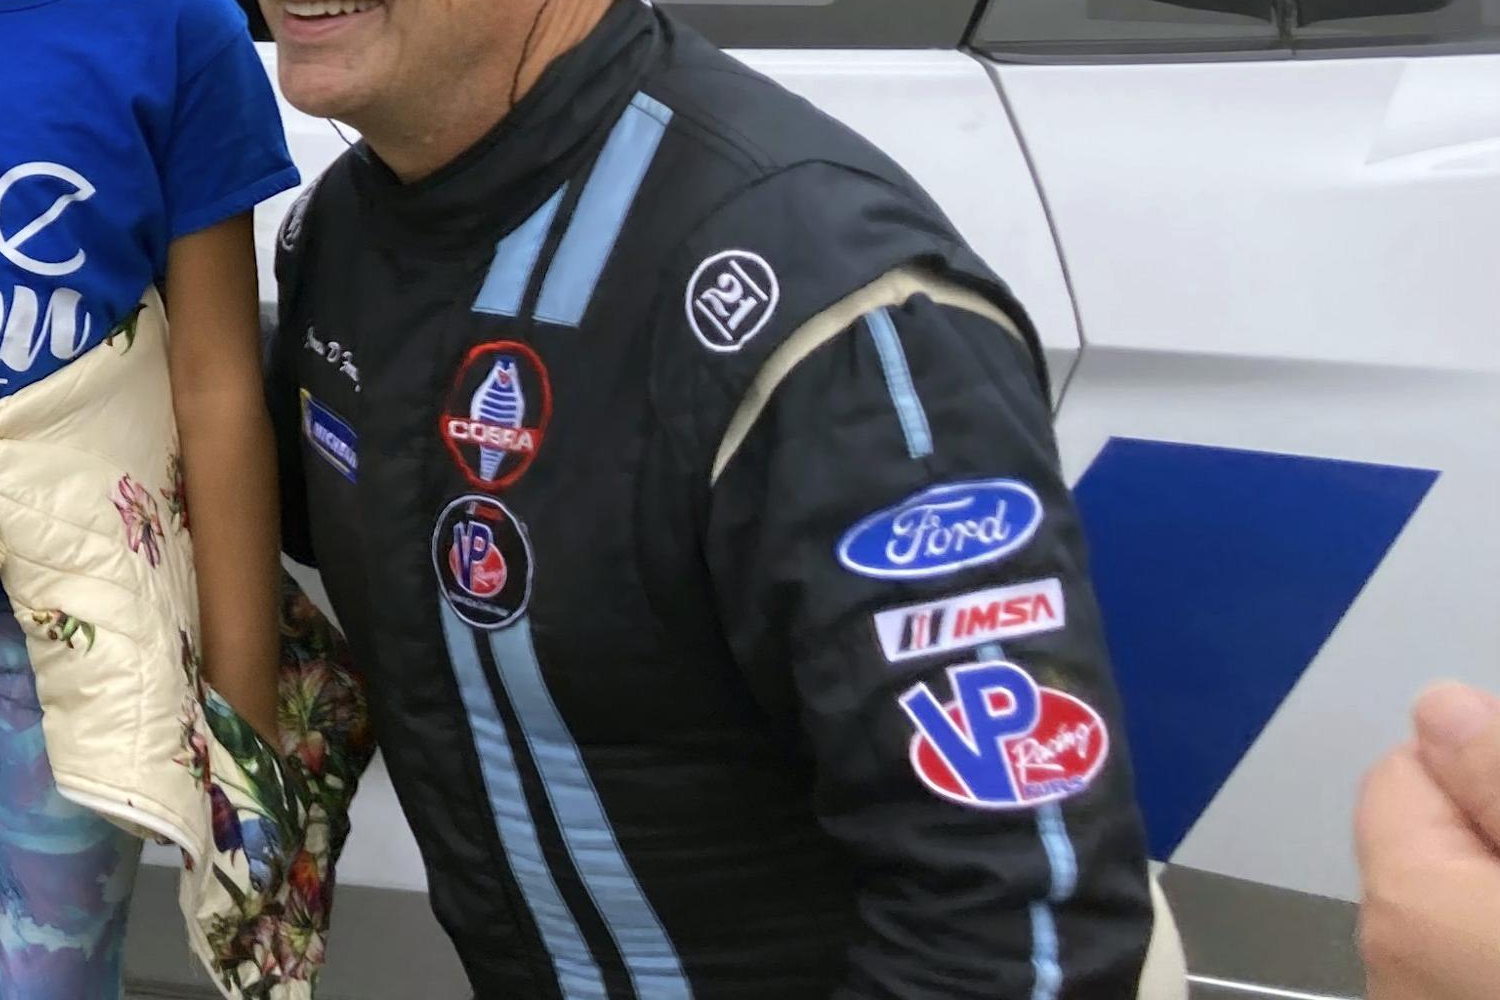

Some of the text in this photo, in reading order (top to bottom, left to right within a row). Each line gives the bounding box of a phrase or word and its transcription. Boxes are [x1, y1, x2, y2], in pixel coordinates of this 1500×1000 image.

[447, 419, 535, 451] COBRA
[885, 496, 1010, 566] Ford
[953, 592, 1057, 640] IMSA
[899, 660, 1041, 805] VP
